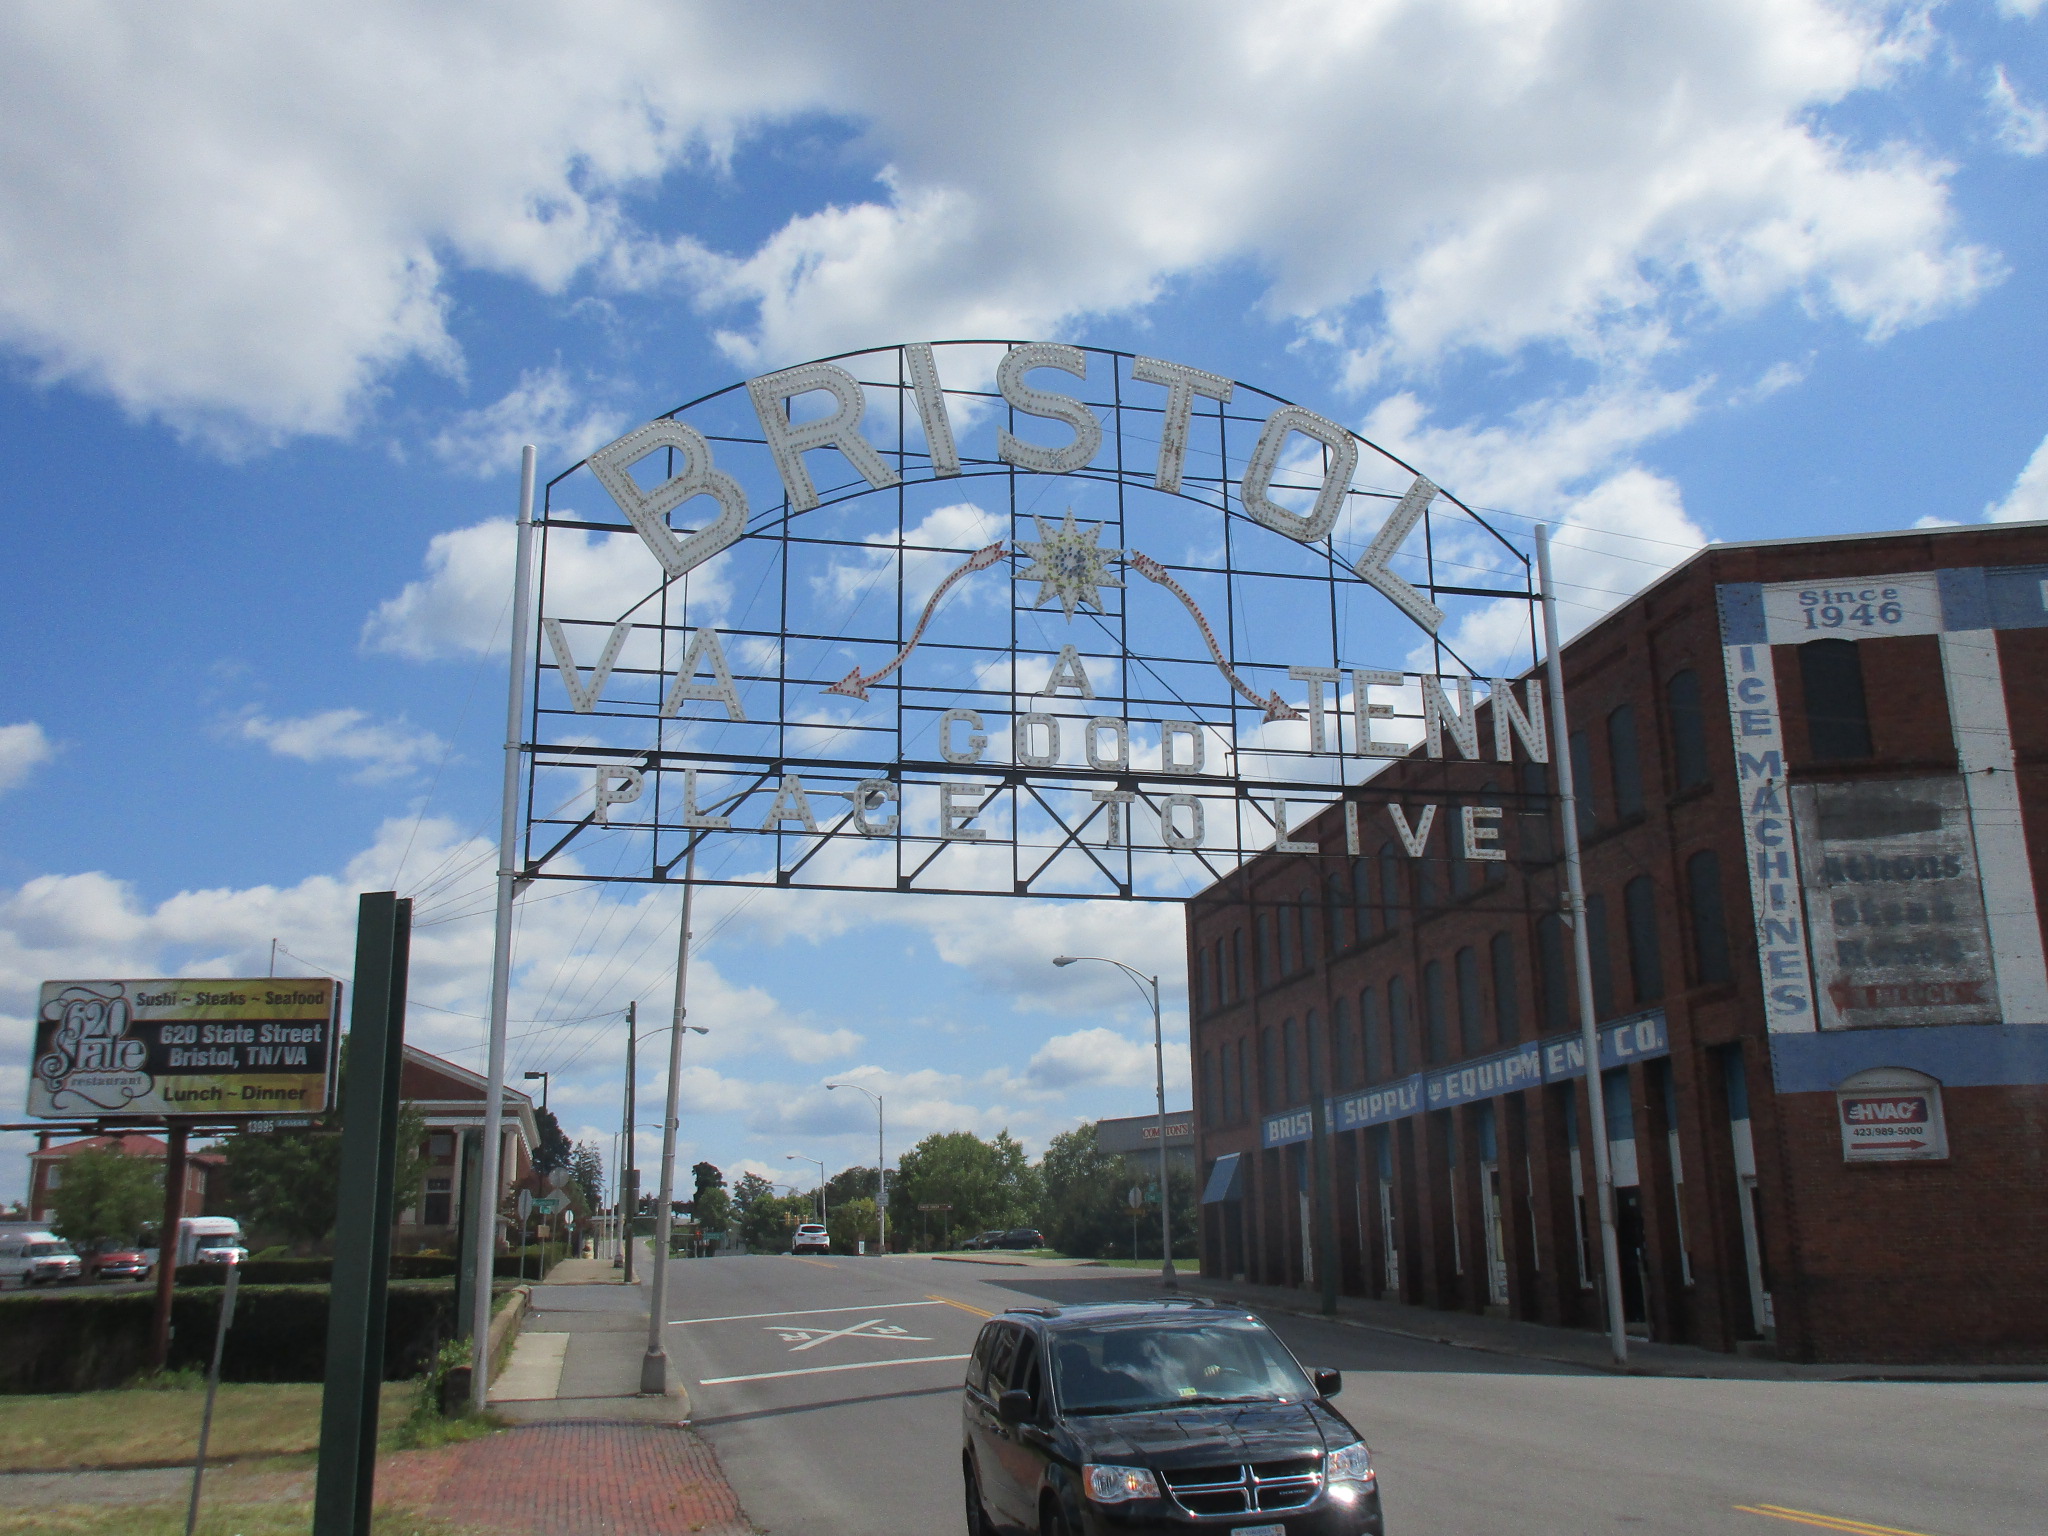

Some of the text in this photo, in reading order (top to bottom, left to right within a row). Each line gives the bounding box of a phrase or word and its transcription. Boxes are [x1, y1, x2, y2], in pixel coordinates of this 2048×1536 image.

[586, 342, 1446, 634] BRISTOL
[1799, 588, 1899, 607] Since
[1802, 601, 1903, 630] 1946
[543, 617, 747, 722] VA
[1043, 644, 1096, 700] A
[1288, 666, 1549, 764] TENN
[939, 708, 1205, 776] GOOD
[595, 764, 1507, 861] PLACE TO LIVE
[1737, 646, 1807, 1016] ICE MACHINES
[63, 1000, 132, 1040] 620
[136, 991, 177, 1006] Sushi
[195, 991, 246, 1006] Steaks
[265, 991, 325, 1005] Seafood
[160, 1023, 322, 1044] 620 State Street
[169, 1046, 308, 1069] Bristol, TN/VA
[163, 1086, 223, 1102] Lunch
[242, 1085, 308, 1101] Dinner
[1268, 1104, 1333, 1142] BRISTL
[1344, 1080, 1420, 1125] SUPPLY
[1446, 1036, 1601, 1101] EQUIPMEN
[1613, 1019, 1664, 1057] CO.
[1849, 1101, 1918, 1120] HVAC
